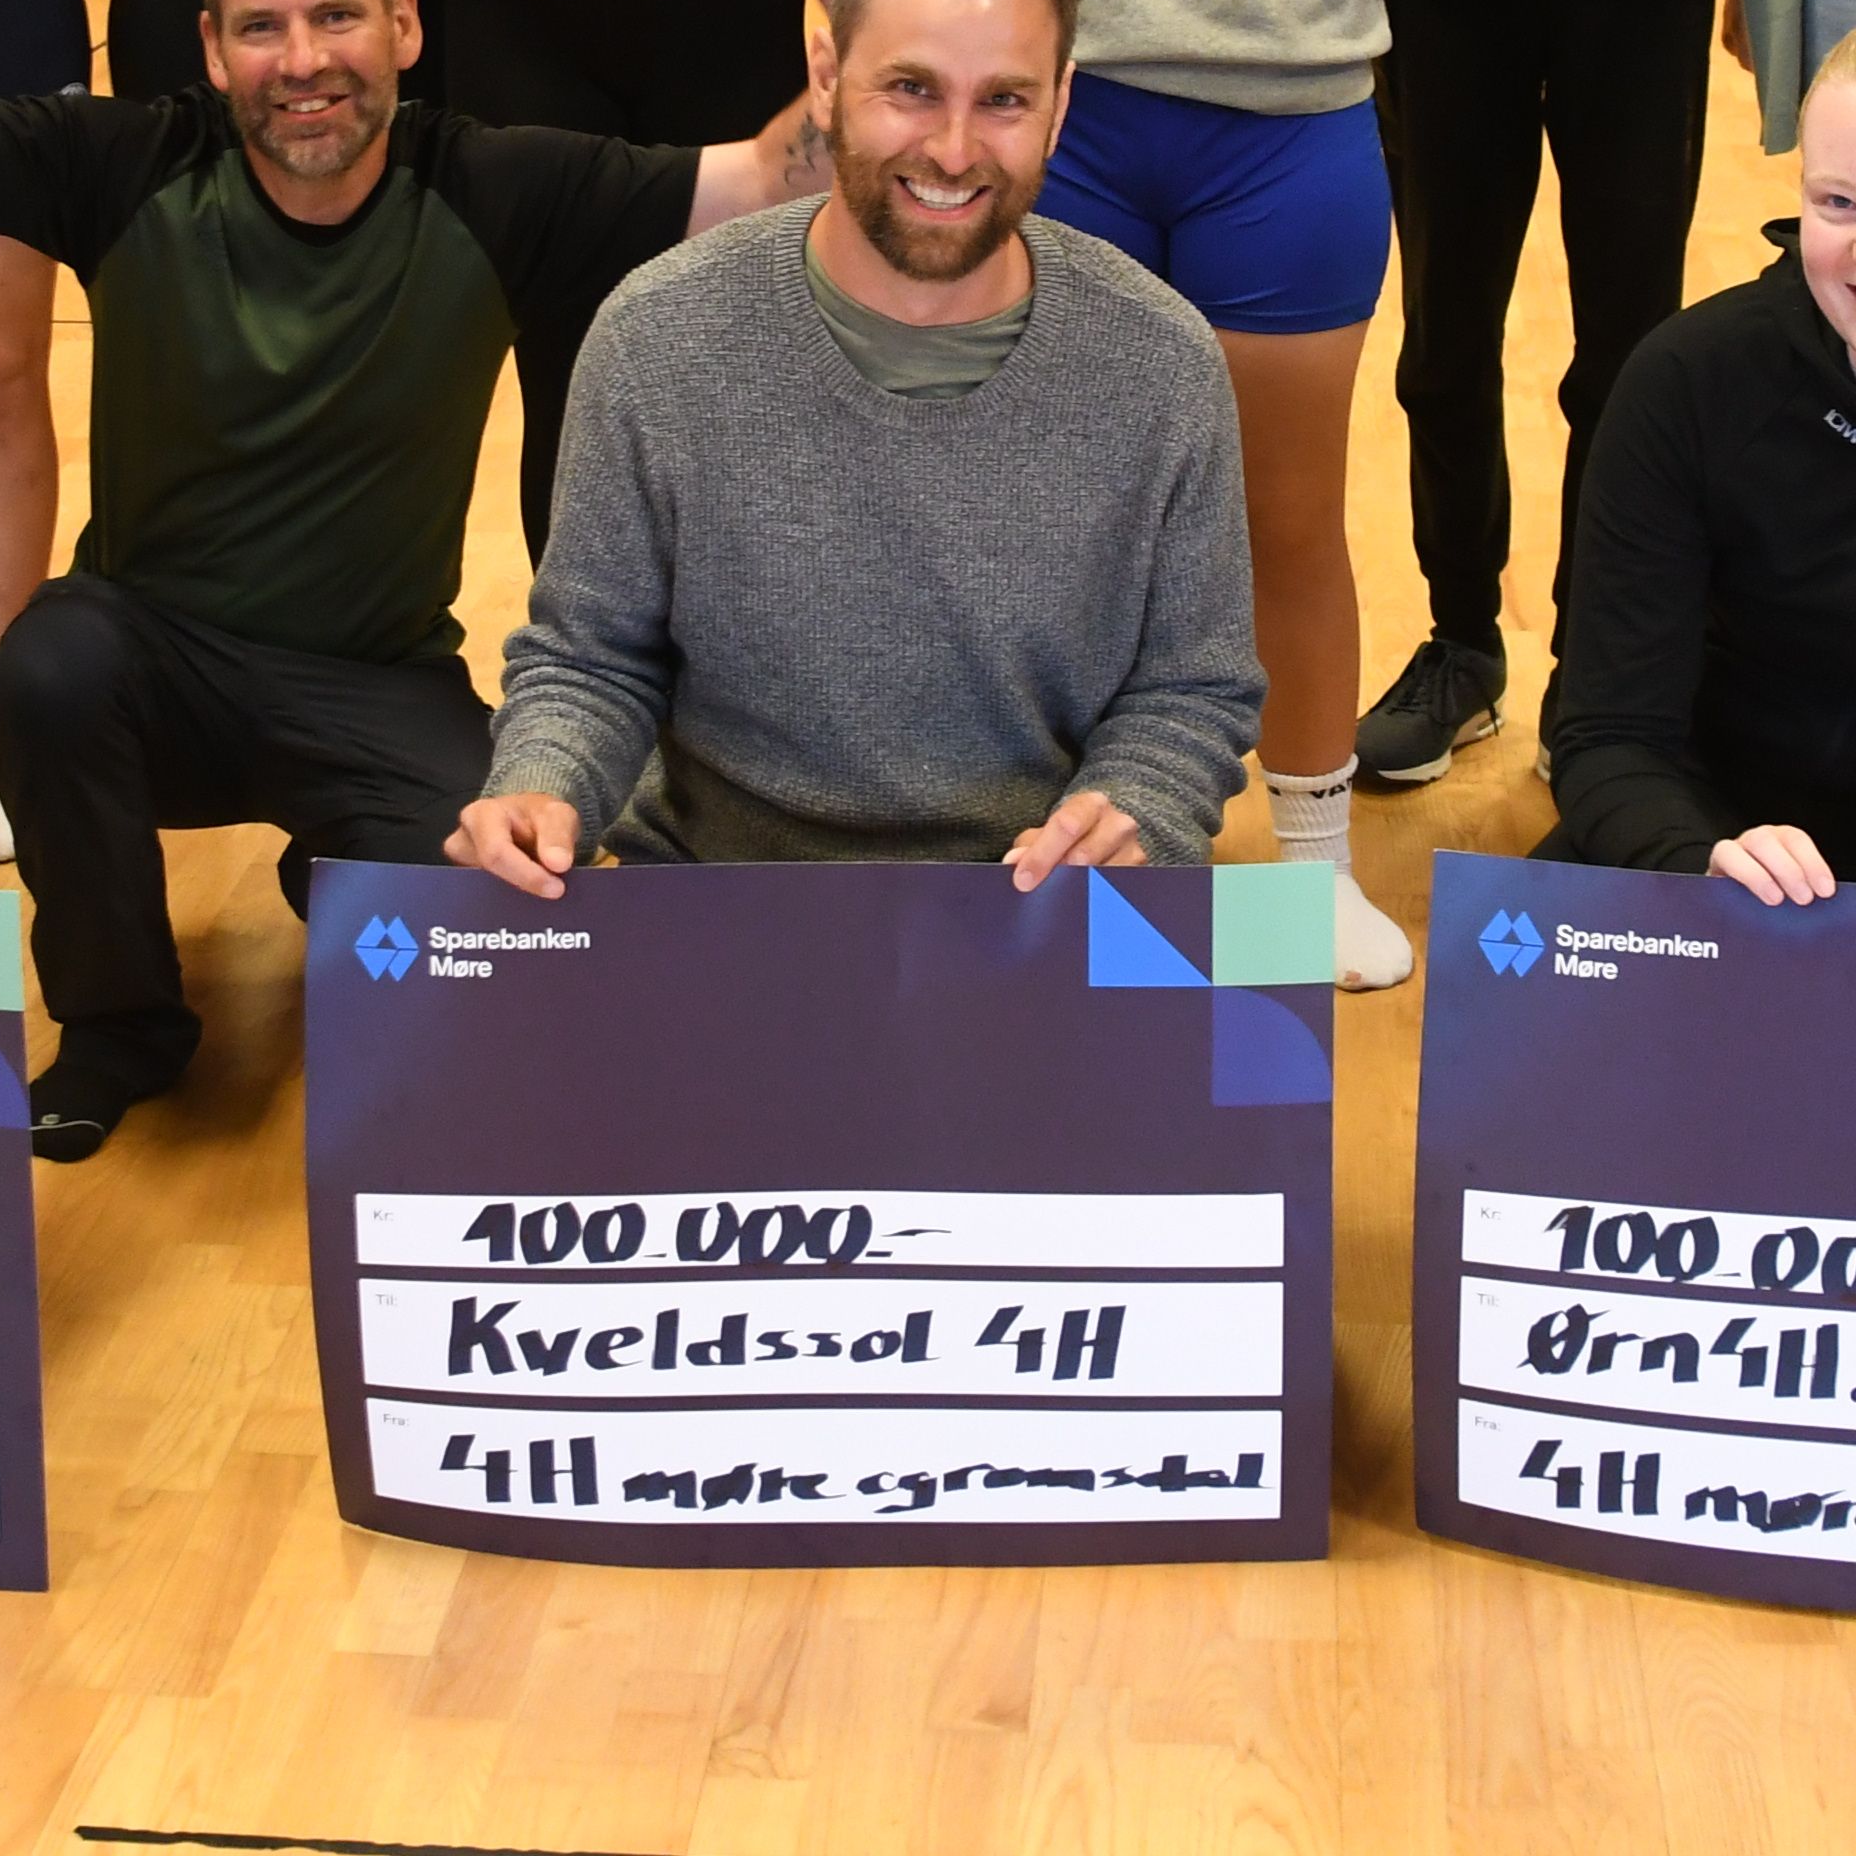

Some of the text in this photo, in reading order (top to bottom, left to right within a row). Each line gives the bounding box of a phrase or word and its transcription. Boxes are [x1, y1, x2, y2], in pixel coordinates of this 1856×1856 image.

[428, 925, 591, 954] Sparebanken
[429, 953, 493, 978] Møre
[1554, 954, 1619, 981] Møre
[1555, 920, 1720, 960] Sparebanken
[447, 1296, 1127, 1381] Kveldssol 4H
[1517, 1303, 1700, 1384] Ørn
[1709, 1317, 1840, 1400] 4H
[440, 1433, 599, 1506] 4H
[1519, 1439, 1662, 1517] 4H
